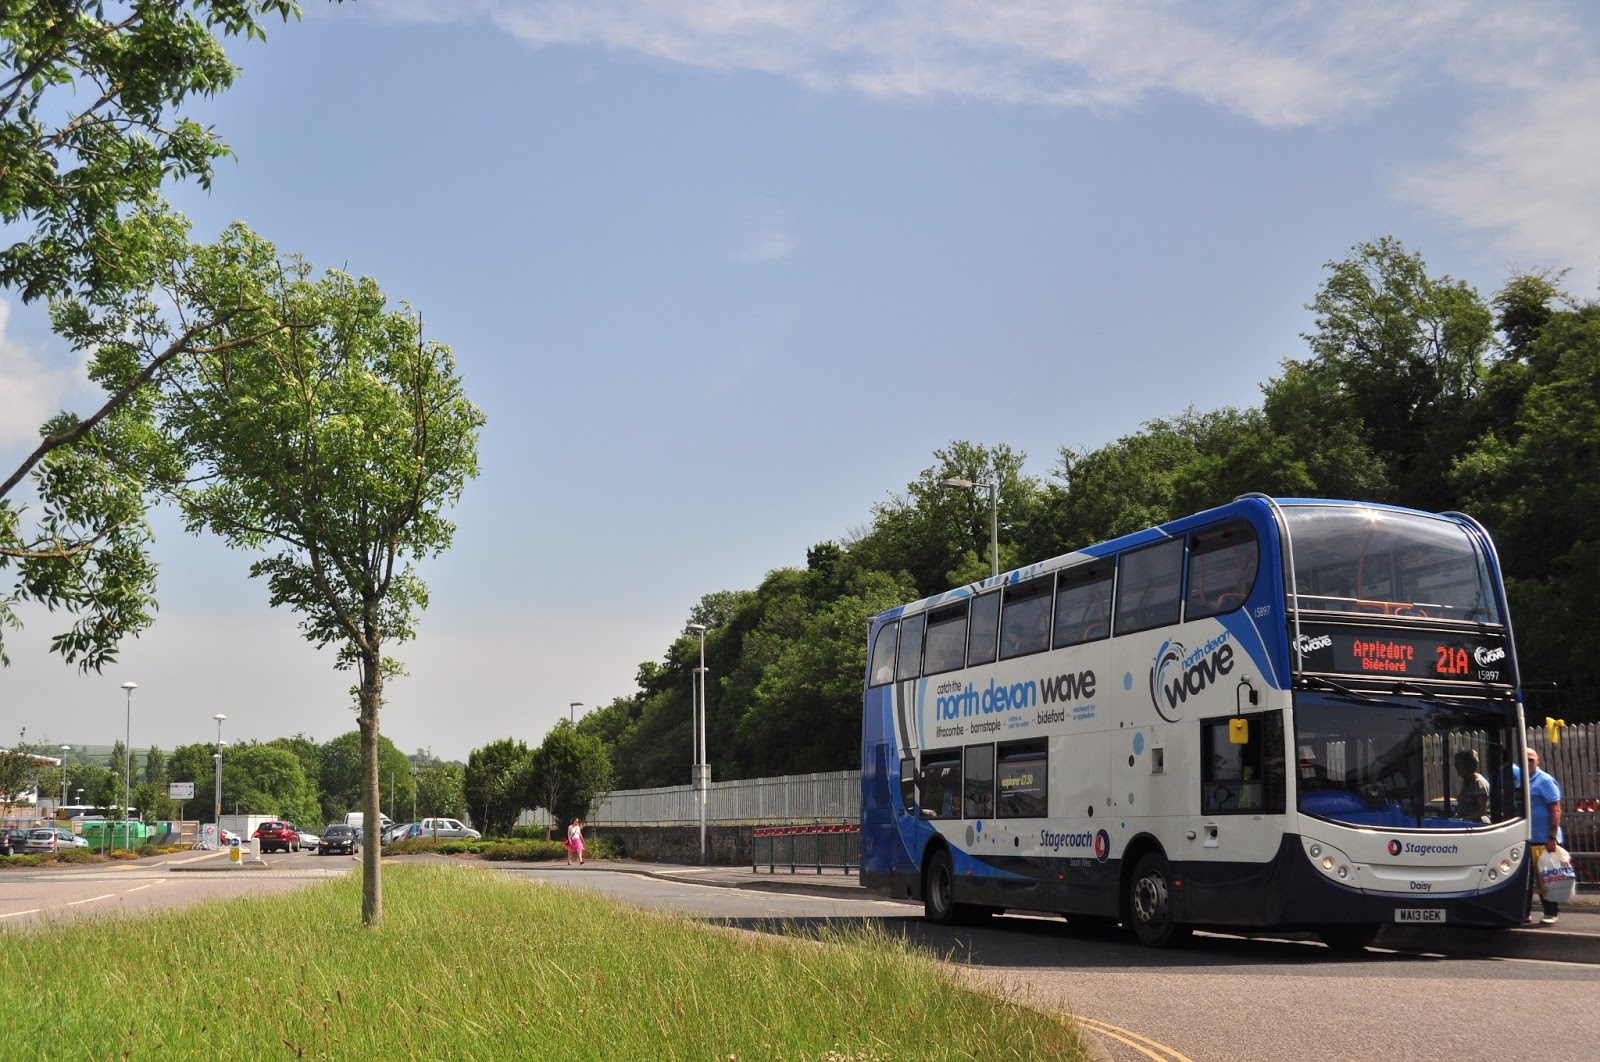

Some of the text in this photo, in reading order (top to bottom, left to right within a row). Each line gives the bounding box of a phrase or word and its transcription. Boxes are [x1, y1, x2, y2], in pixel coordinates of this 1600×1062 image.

[1254, 605, 1271, 618] 15897
[1181, 630, 1230, 671] north devon
[1300, 637, 1333, 653] wave
[1353, 639, 1414, 660] Appledore
[1362, 657, 1406, 672] Bideford
[1436, 646, 1468, 674] 21A
[1480, 650, 1506, 665] wave
[1164, 643, 1234, 710] wave
[1477, 670, 1500, 681] 15897
[936, 669, 1096, 721] north devon wave
[937, 679, 962, 695] catch the
[970, 717, 1001, 735] barnstaple
[1037, 708, 1065, 725] bideford
[1040, 829, 1093, 852] Stagecoach
[1405, 842, 1458, 856] Stagecoach
[1410, 881, 1432, 892] Daisy
[1400, 910, 1441, 921] WA13 GEK
